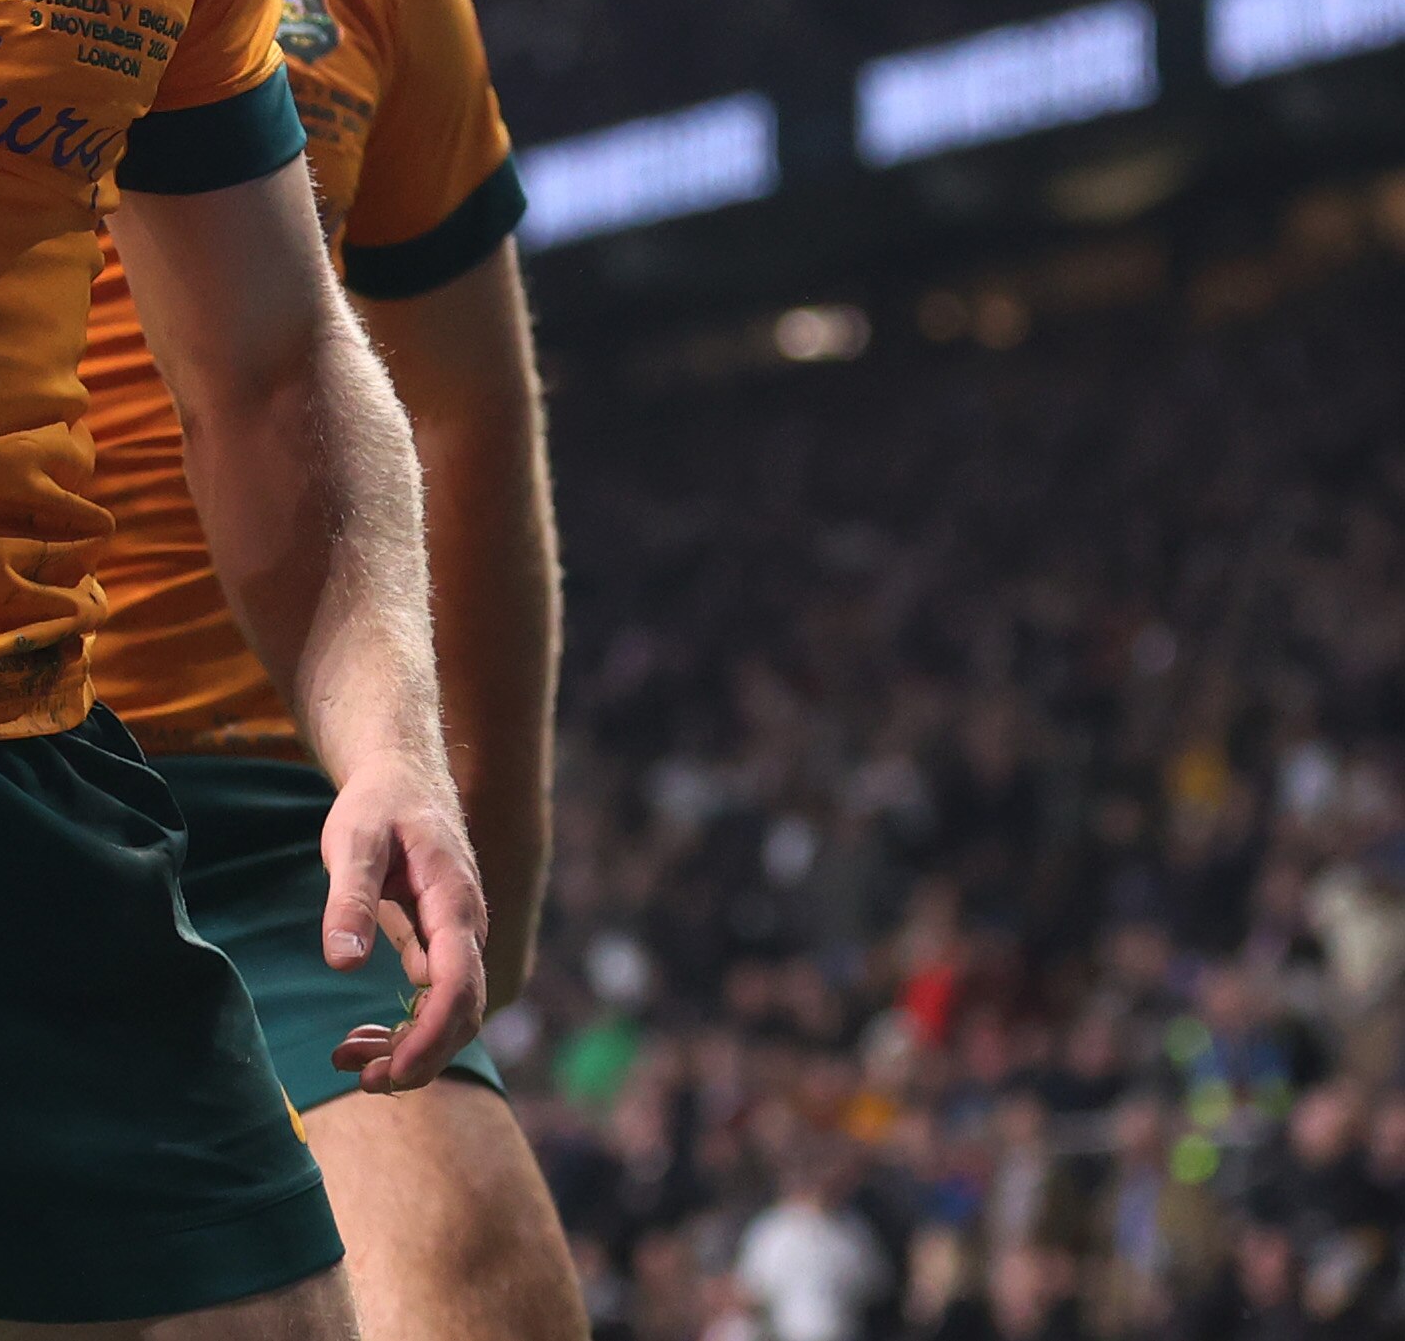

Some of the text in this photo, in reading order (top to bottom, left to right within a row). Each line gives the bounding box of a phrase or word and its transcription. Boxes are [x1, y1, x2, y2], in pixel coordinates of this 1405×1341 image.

[30, 9, 43, 27] 9
[51, 12, 142, 52] NOVEMBER
[120, 4, 133, 22] V
[138, 7, 184, 41] ENGLAN
[77, 44, 141, 78] LONDON
